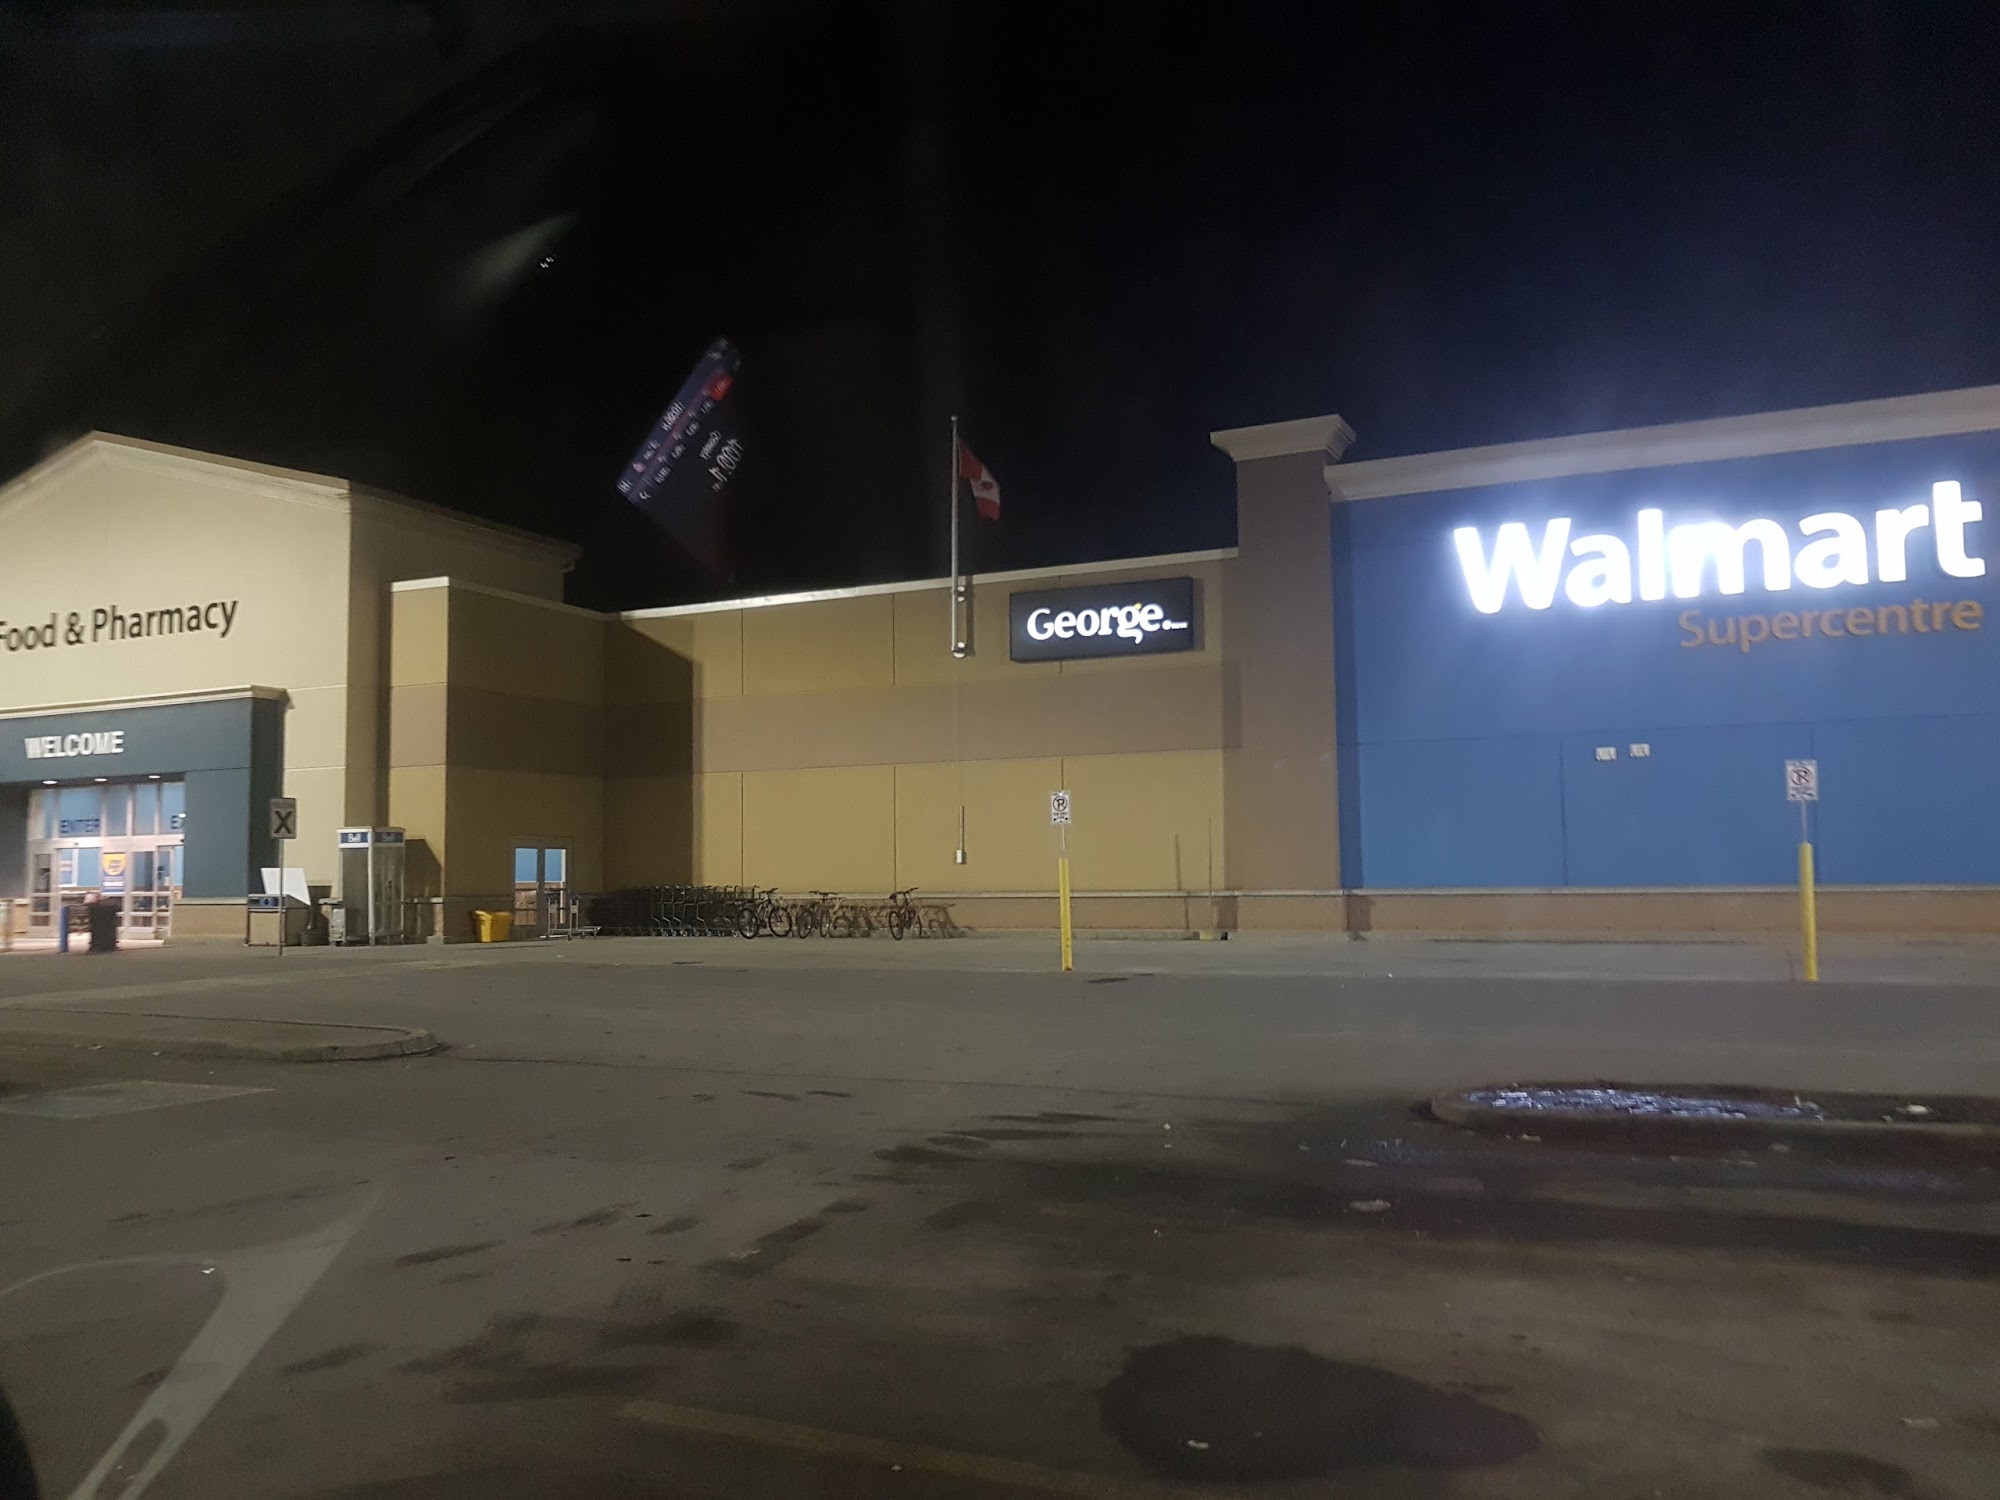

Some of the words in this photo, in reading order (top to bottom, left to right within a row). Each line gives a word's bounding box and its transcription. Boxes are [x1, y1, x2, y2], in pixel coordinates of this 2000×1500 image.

[1452, 480, 1986, 615] Walmart
[65, 612, 85, 645] &
[92, 600, 239, 643] Pharmacy
[1678, 598, 1984, 653] Supercentre
[24, 730, 125, 759] WELCOME
